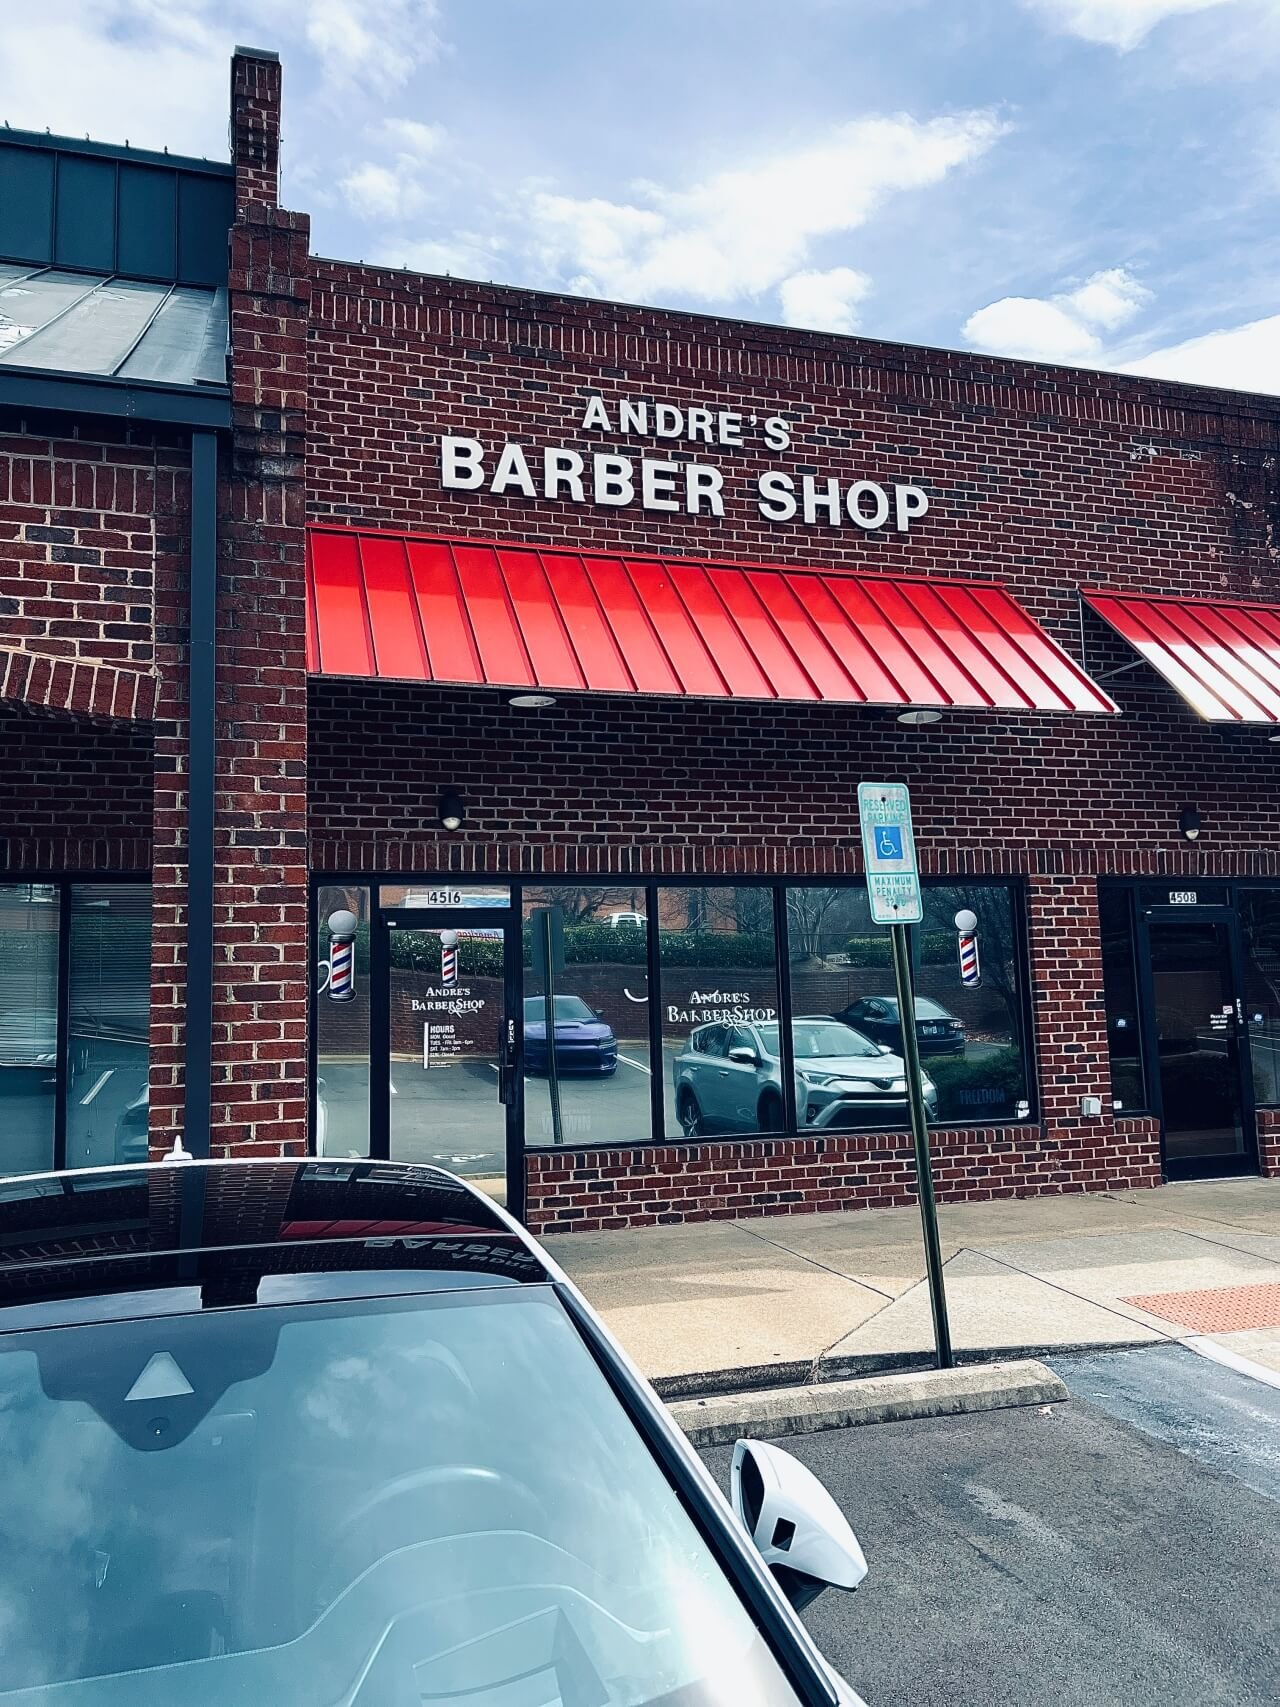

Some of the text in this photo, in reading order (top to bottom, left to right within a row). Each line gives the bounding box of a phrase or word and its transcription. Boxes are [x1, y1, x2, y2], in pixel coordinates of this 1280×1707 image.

[582, 396, 791, 451] ANDRE'S
[440, 435, 930, 532] BARBER SHOP
[863, 799, 906, 811] RESERVED
[874, 876, 912, 886] MAXIMUM
[429, 891, 461, 904] 4516
[876, 887, 912, 896] PENALTY
[1170, 892, 1196, 903] 4508
[425, 986, 471, 997] ANDRE'S
[690, 989, 750, 1004] ANDRE'S
[429, 1025, 455, 1034] HOURS
[959, 1087, 1006, 1105] FREEDOM
